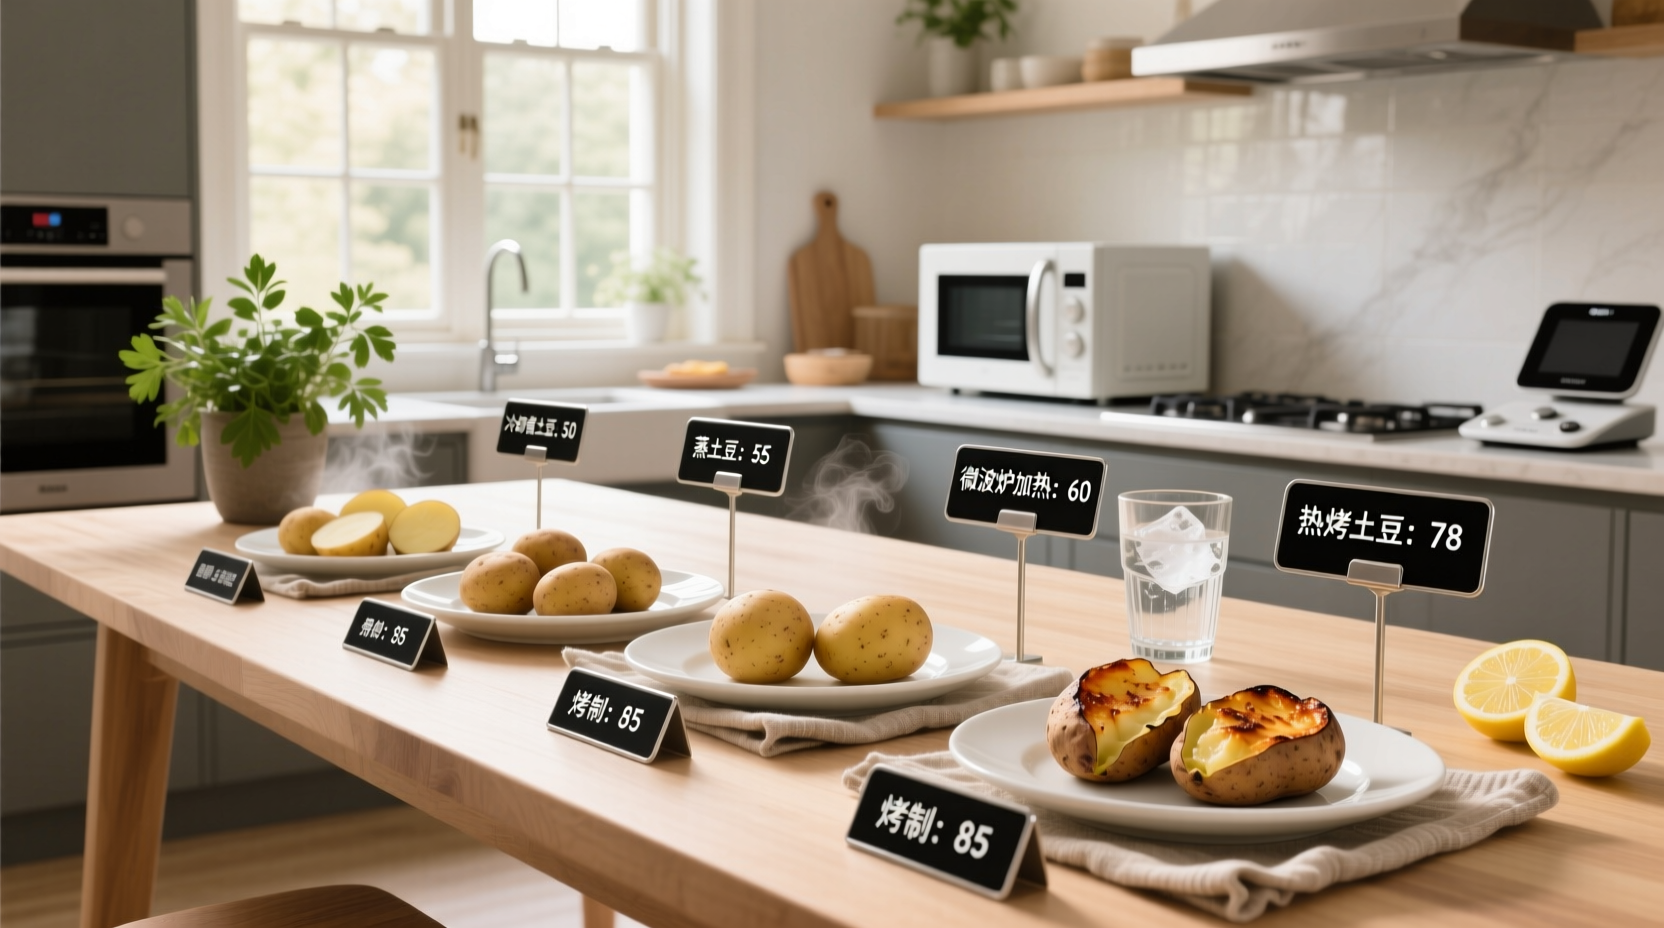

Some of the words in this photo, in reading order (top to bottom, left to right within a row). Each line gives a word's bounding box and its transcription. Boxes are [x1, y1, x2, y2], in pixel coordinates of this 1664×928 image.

[561, 421, 577, 439] 50
[751, 443, 772, 465] 55
[1067, 479, 1092, 503] 60
[1430, 521, 1464, 551] 78
[617, 705, 645, 733] 85
[953, 820, 994, 859] 85
